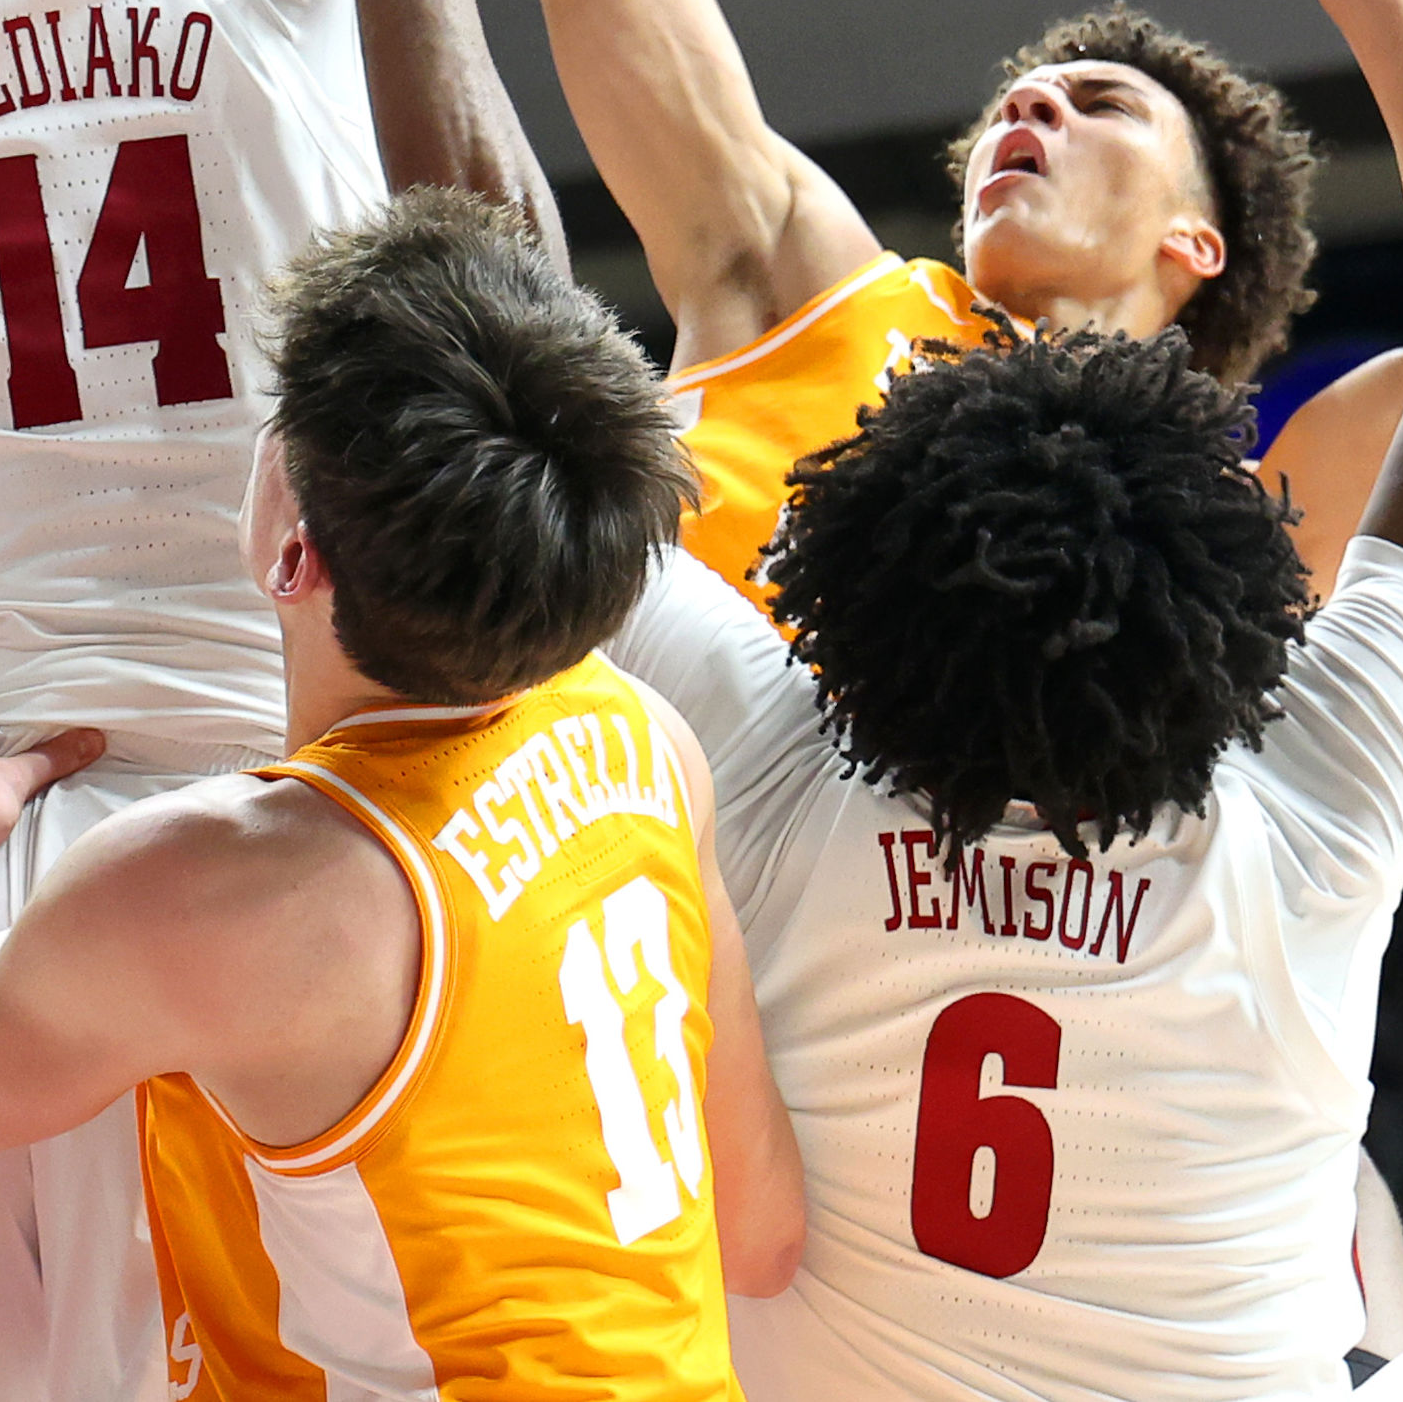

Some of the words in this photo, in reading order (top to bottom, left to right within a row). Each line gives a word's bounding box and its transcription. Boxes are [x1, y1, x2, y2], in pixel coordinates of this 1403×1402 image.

[431, 712, 679, 923] ESTRELLA
[878, 829, 1151, 964] JEMISON
[558, 875, 704, 1246] 13
[910, 991, 1062, 1280] 6
